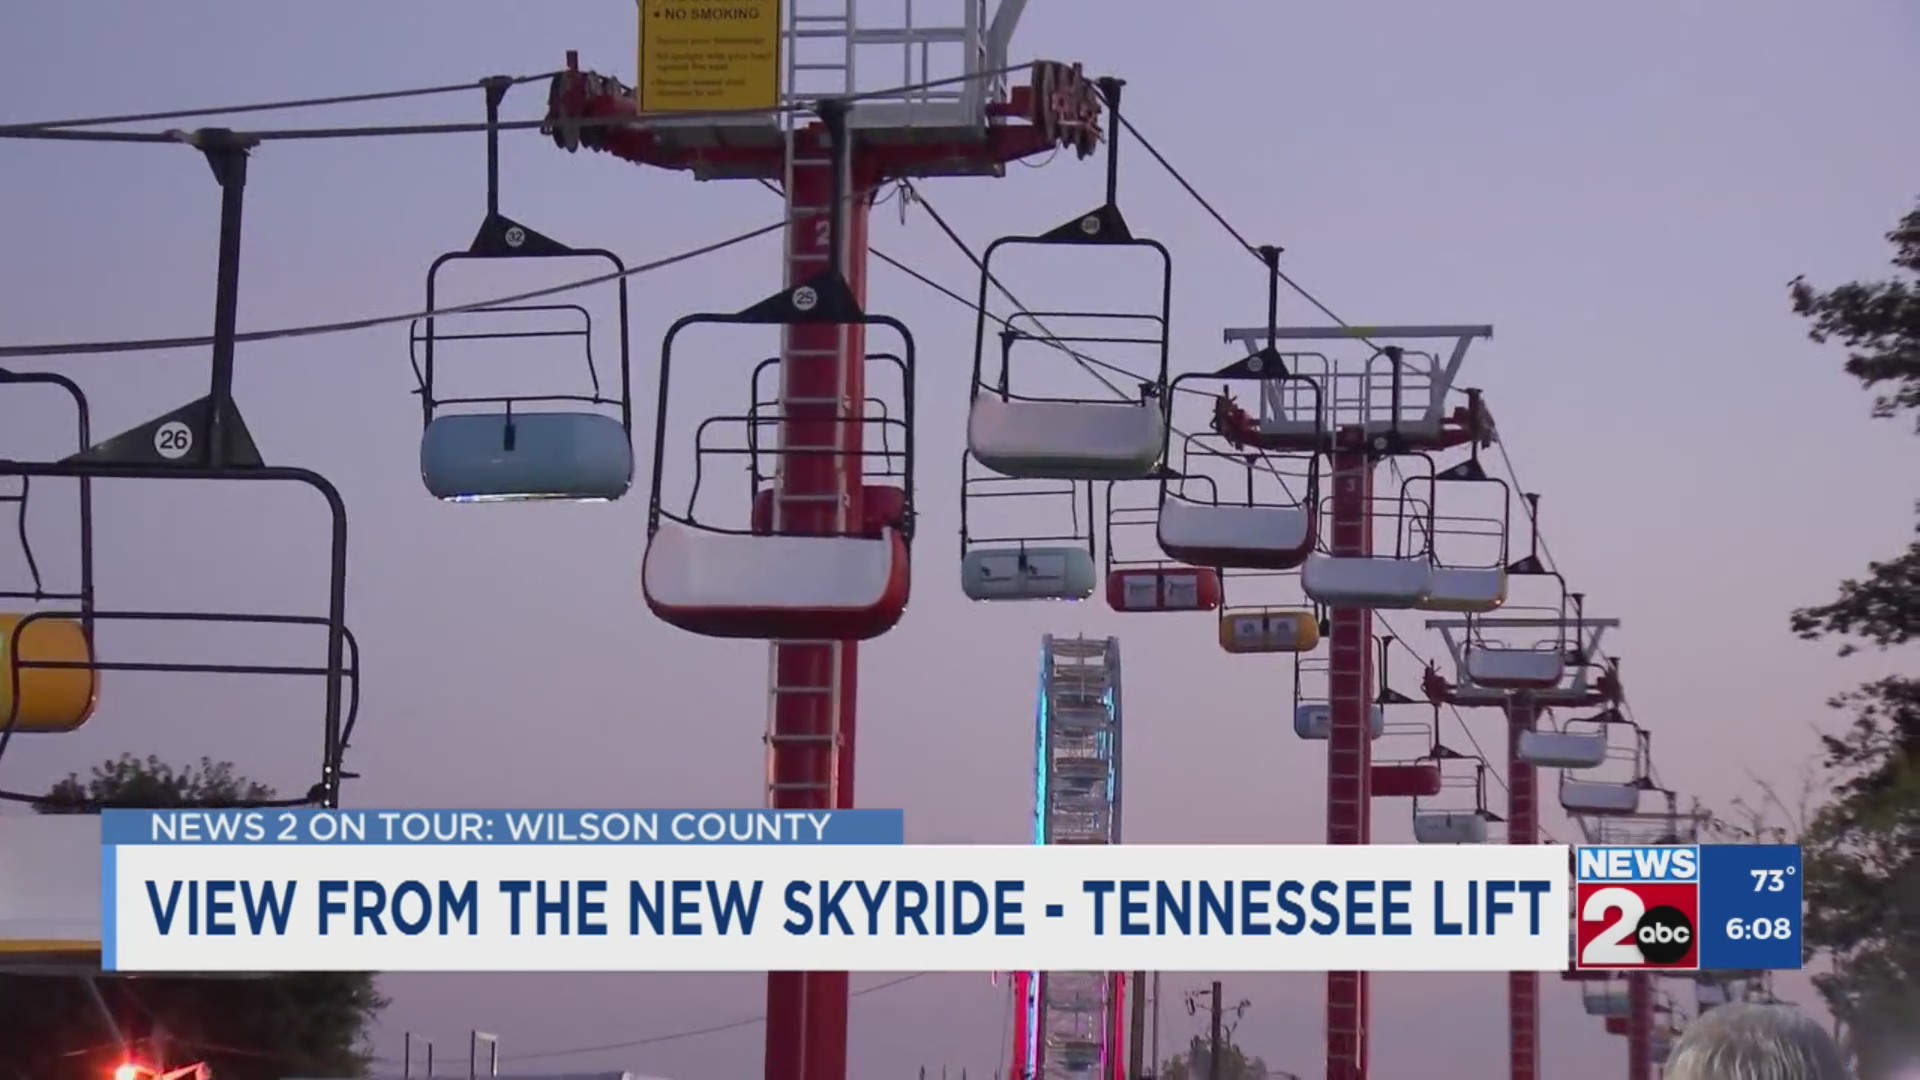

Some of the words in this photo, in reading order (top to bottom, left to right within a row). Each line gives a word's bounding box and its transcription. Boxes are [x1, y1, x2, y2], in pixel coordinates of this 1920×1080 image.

[664, 8, 686, 20] NO
[690, 8, 759, 20] SMOKING
[509, 230, 523, 241] 32
[815, 220, 830, 246] 2
[796, 290, 815, 305] 25
[160, 429, 188, 450] 26
